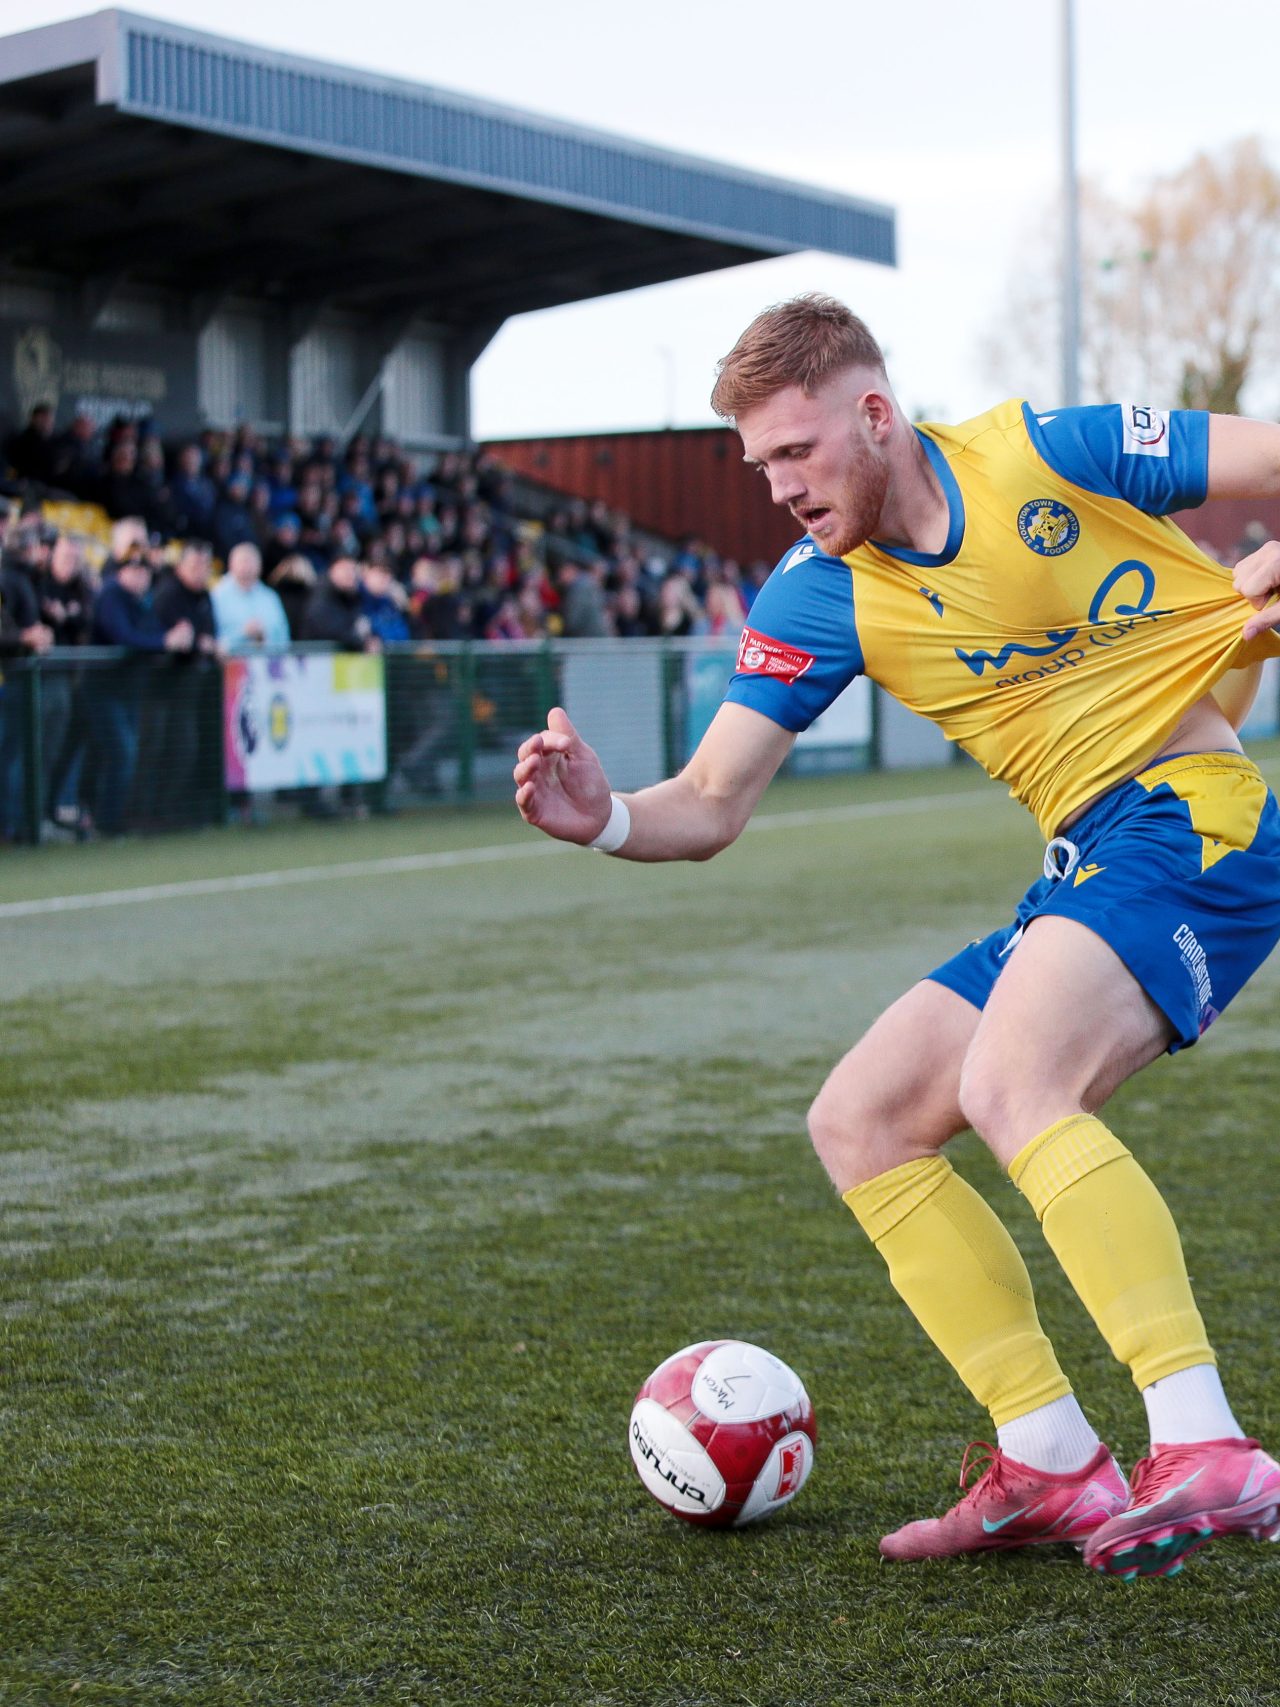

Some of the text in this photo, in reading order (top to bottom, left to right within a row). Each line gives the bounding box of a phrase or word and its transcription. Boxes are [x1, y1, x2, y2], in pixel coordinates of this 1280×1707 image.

[1018, 500, 1054, 545] STOCKTON TOWN
[1044, 511, 1078, 555] FOOTBALL CLUB
[750, 638, 782, 655] PARTNERS
[702, 1374, 735, 1410] MATCH
